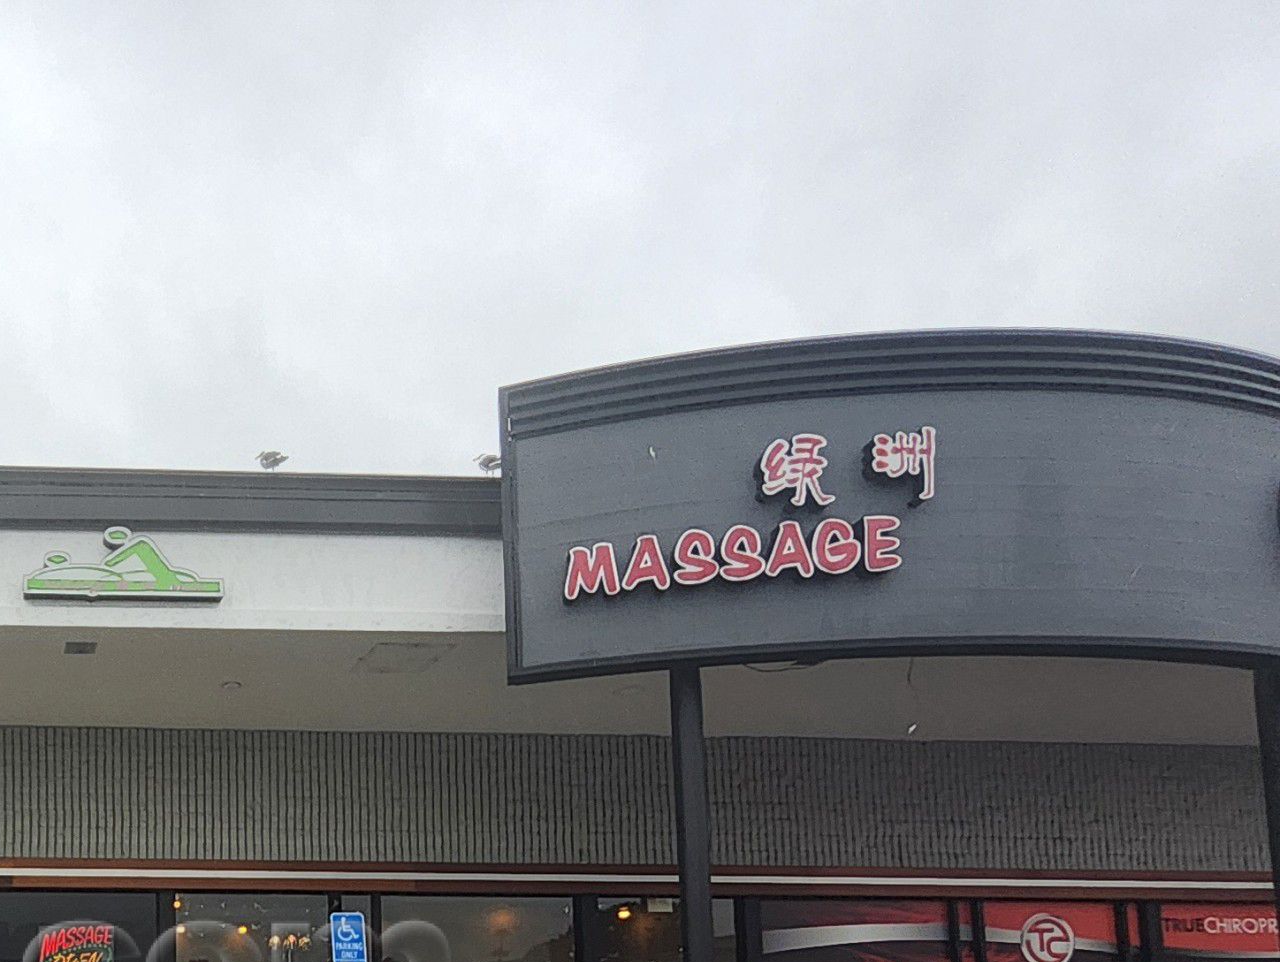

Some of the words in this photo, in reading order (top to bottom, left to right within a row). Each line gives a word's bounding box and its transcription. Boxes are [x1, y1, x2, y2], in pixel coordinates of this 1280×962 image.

[761, 426, 936, 507] 绿洲
[564, 515, 903, 600] MASSAGE
[335, 942, 363, 951] PARKING
[341, 951, 358, 959] ONLY
